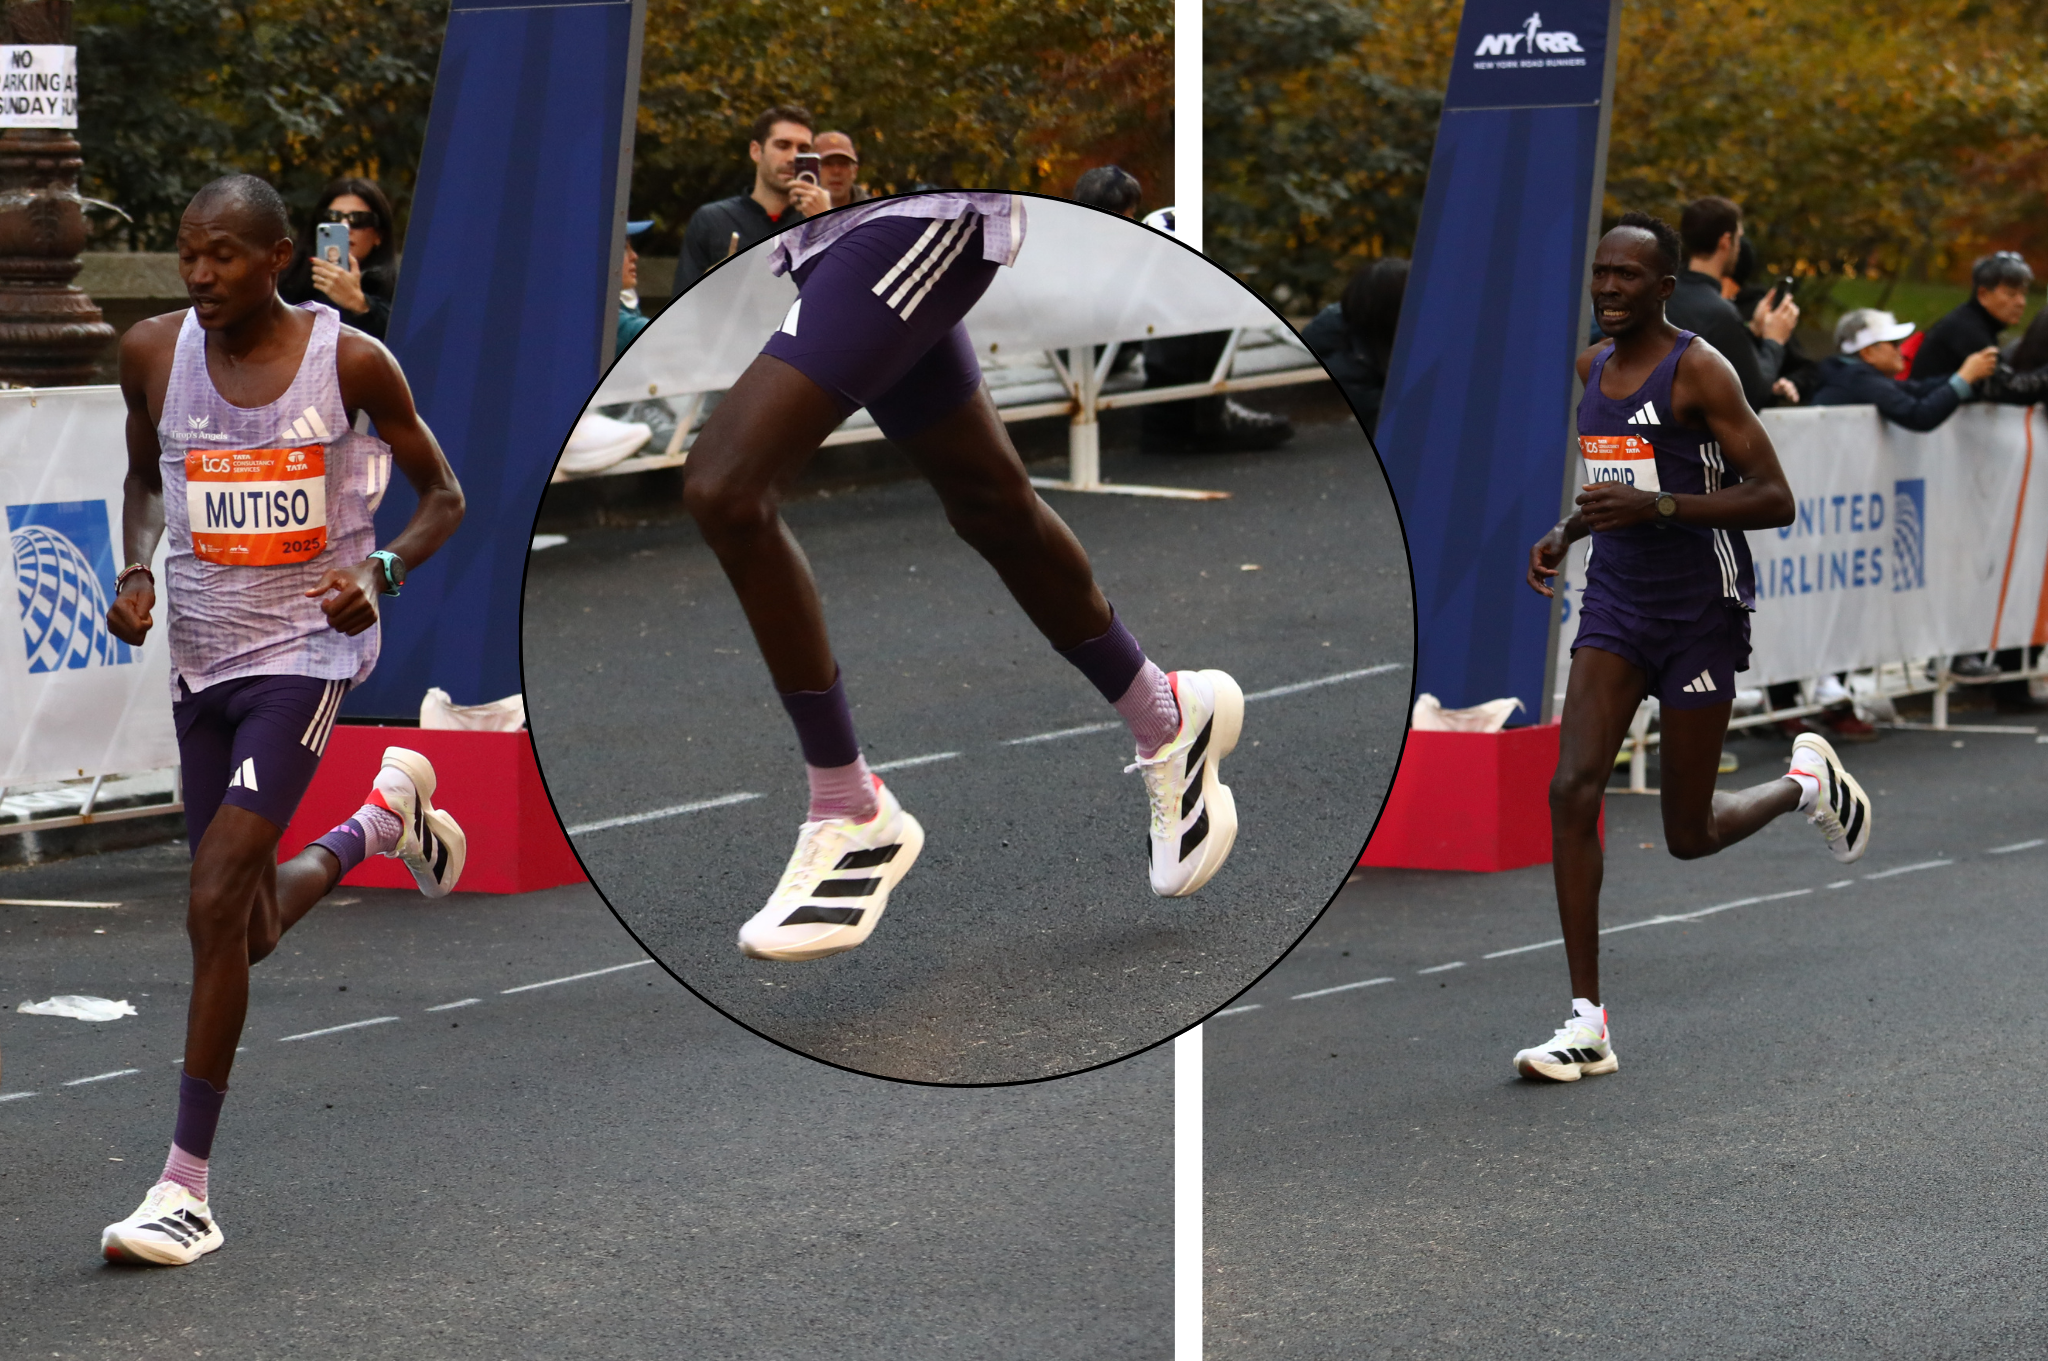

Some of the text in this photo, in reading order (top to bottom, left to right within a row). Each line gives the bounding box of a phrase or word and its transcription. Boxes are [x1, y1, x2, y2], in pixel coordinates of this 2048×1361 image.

[12, 50, 33, 69] NO
[1473, 57, 1587, 70] NEW YORK ROAD RUNNERS
[0, 73, 60, 92] ARKING
[171, 430, 228, 441] Tirop's Angels
[285, 463, 308, 472] TATA
[205, 489, 309, 529] MUTISO
[282, 538, 320, 553] 2025
